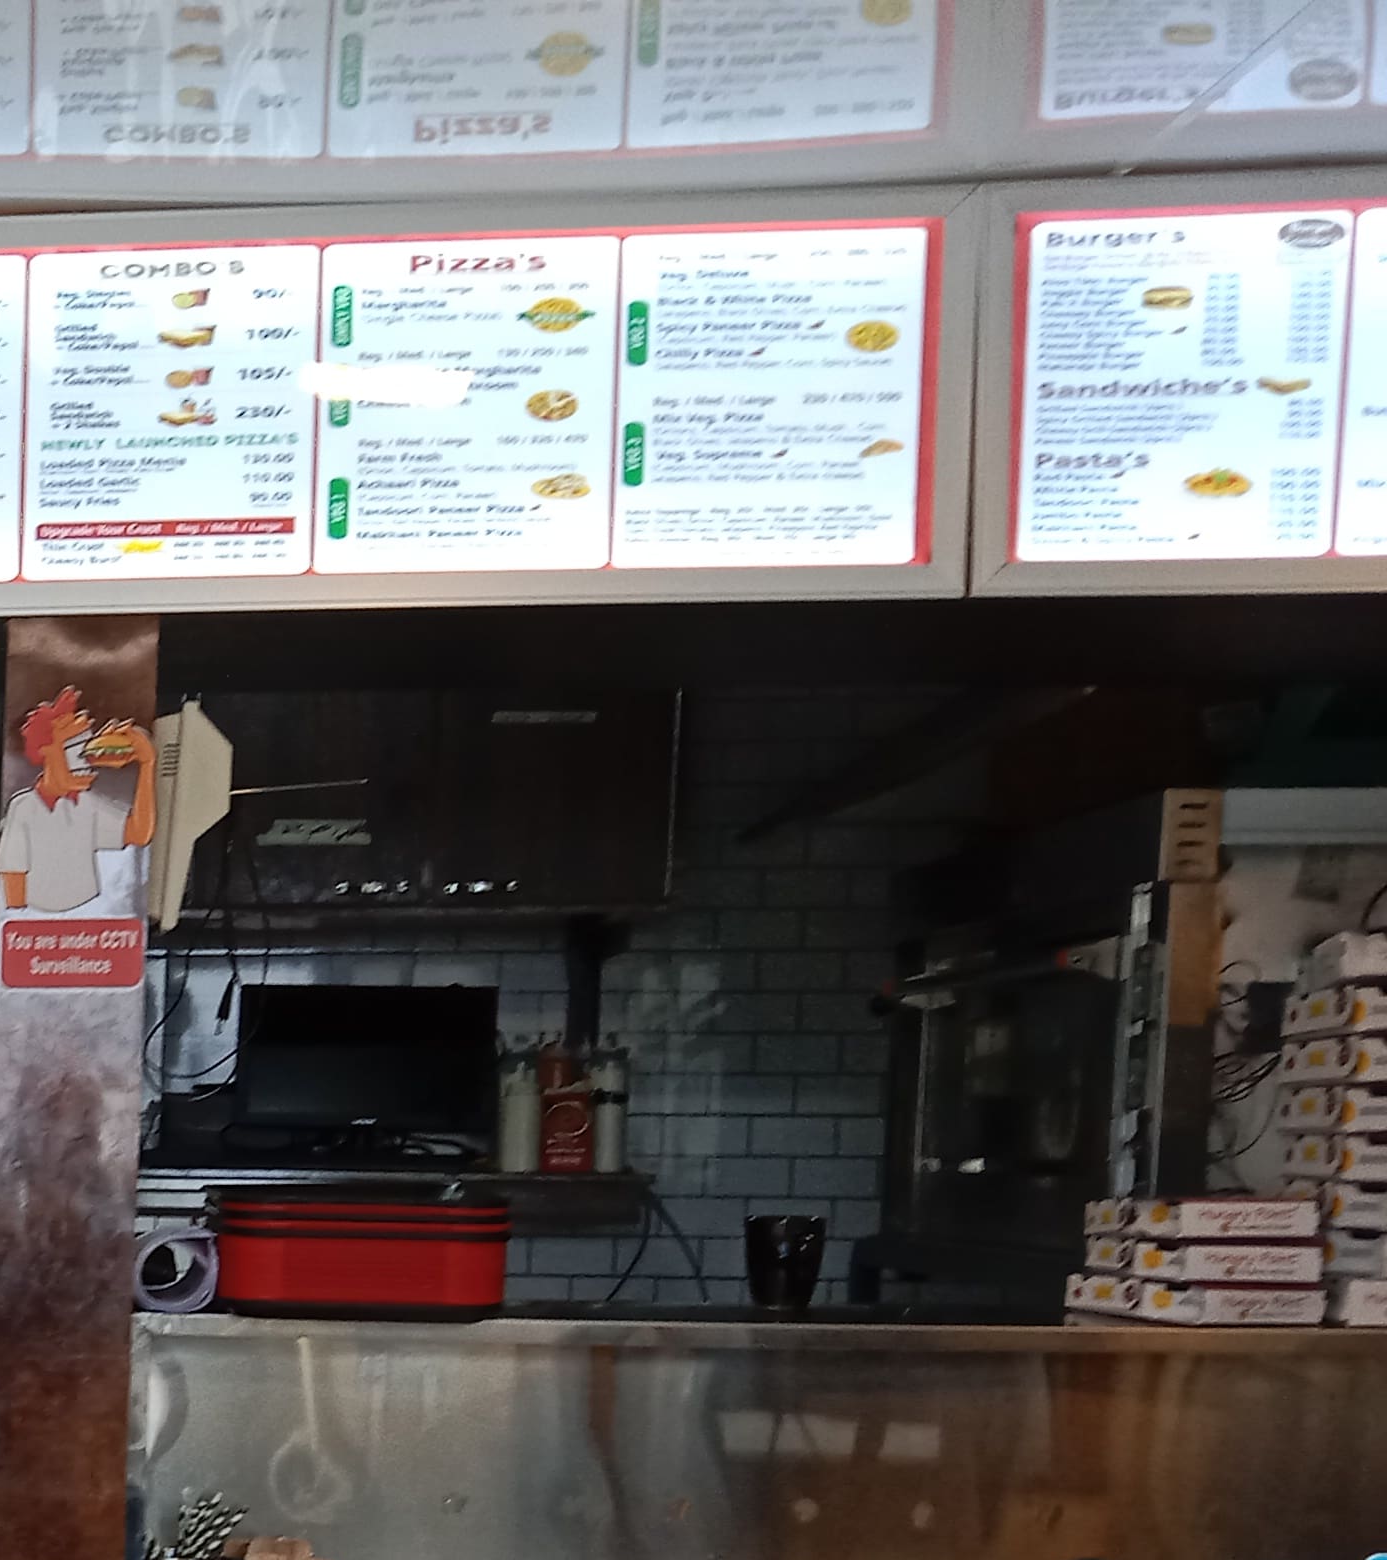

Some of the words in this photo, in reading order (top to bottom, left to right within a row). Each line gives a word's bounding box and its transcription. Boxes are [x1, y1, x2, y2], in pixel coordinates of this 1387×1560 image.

[1045, 231, 1186, 248] Burgers
[100, 260, 245, 279] COMBOS
[410, 253, 547, 275] Pizza's
[6, 931, 33, 950] You
[59, 932, 99, 950] under
[100, 930, 139, 950] CCTV
